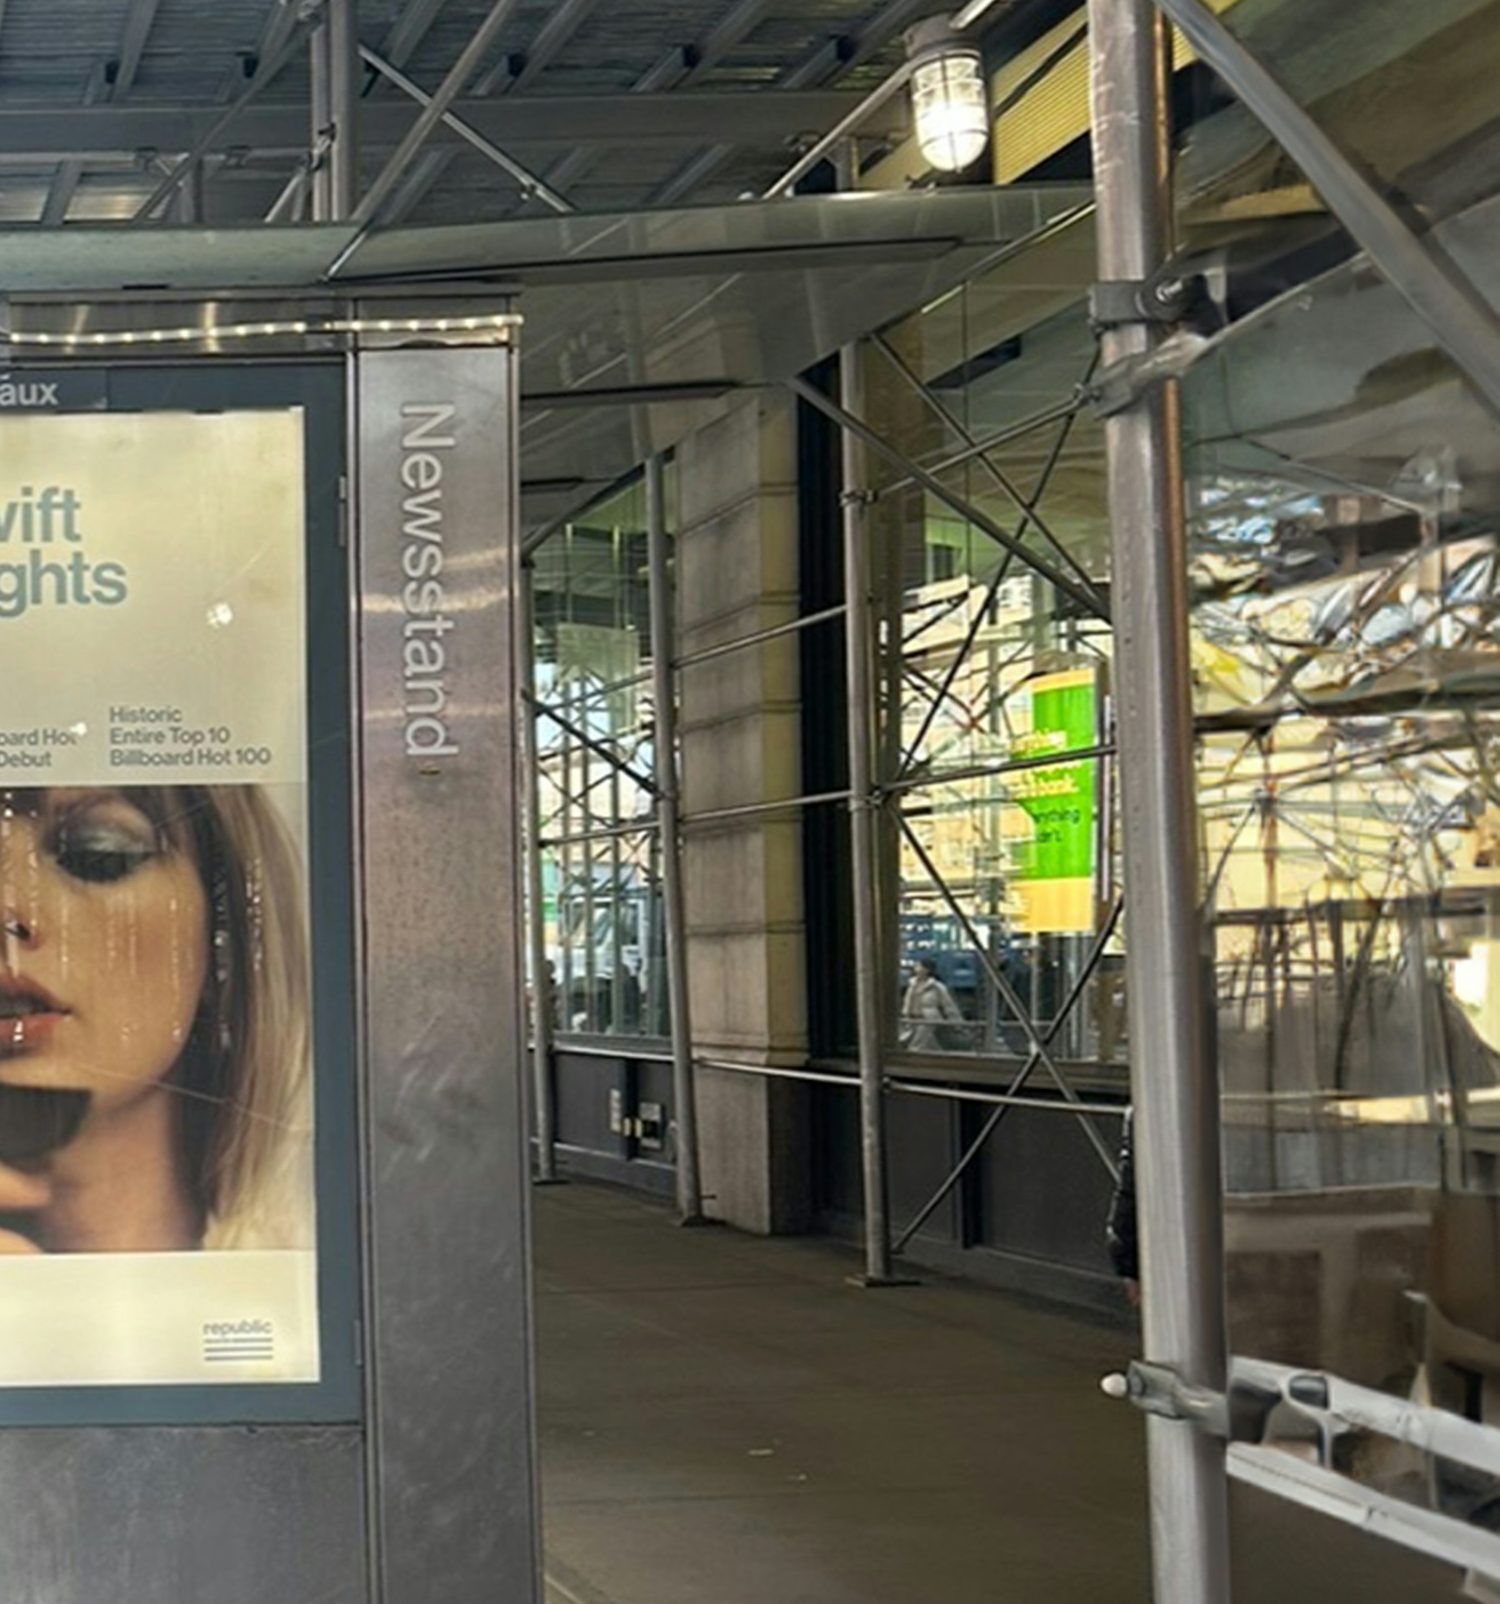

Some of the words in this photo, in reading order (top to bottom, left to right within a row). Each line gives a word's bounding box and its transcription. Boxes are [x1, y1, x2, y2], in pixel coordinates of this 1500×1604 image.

[401, 403, 460, 756] Newsstand
[110, 706, 182, 724] Historic
[110, 727, 166, 745] Entire
[168, 727, 205, 749] Top
[208, 727, 231, 744] 10
[110, 748, 194, 767] Billboard
[198, 748, 232, 766] Hot
[235, 747, 271, 765] 100
[203, 1319, 272, 1337] republic
